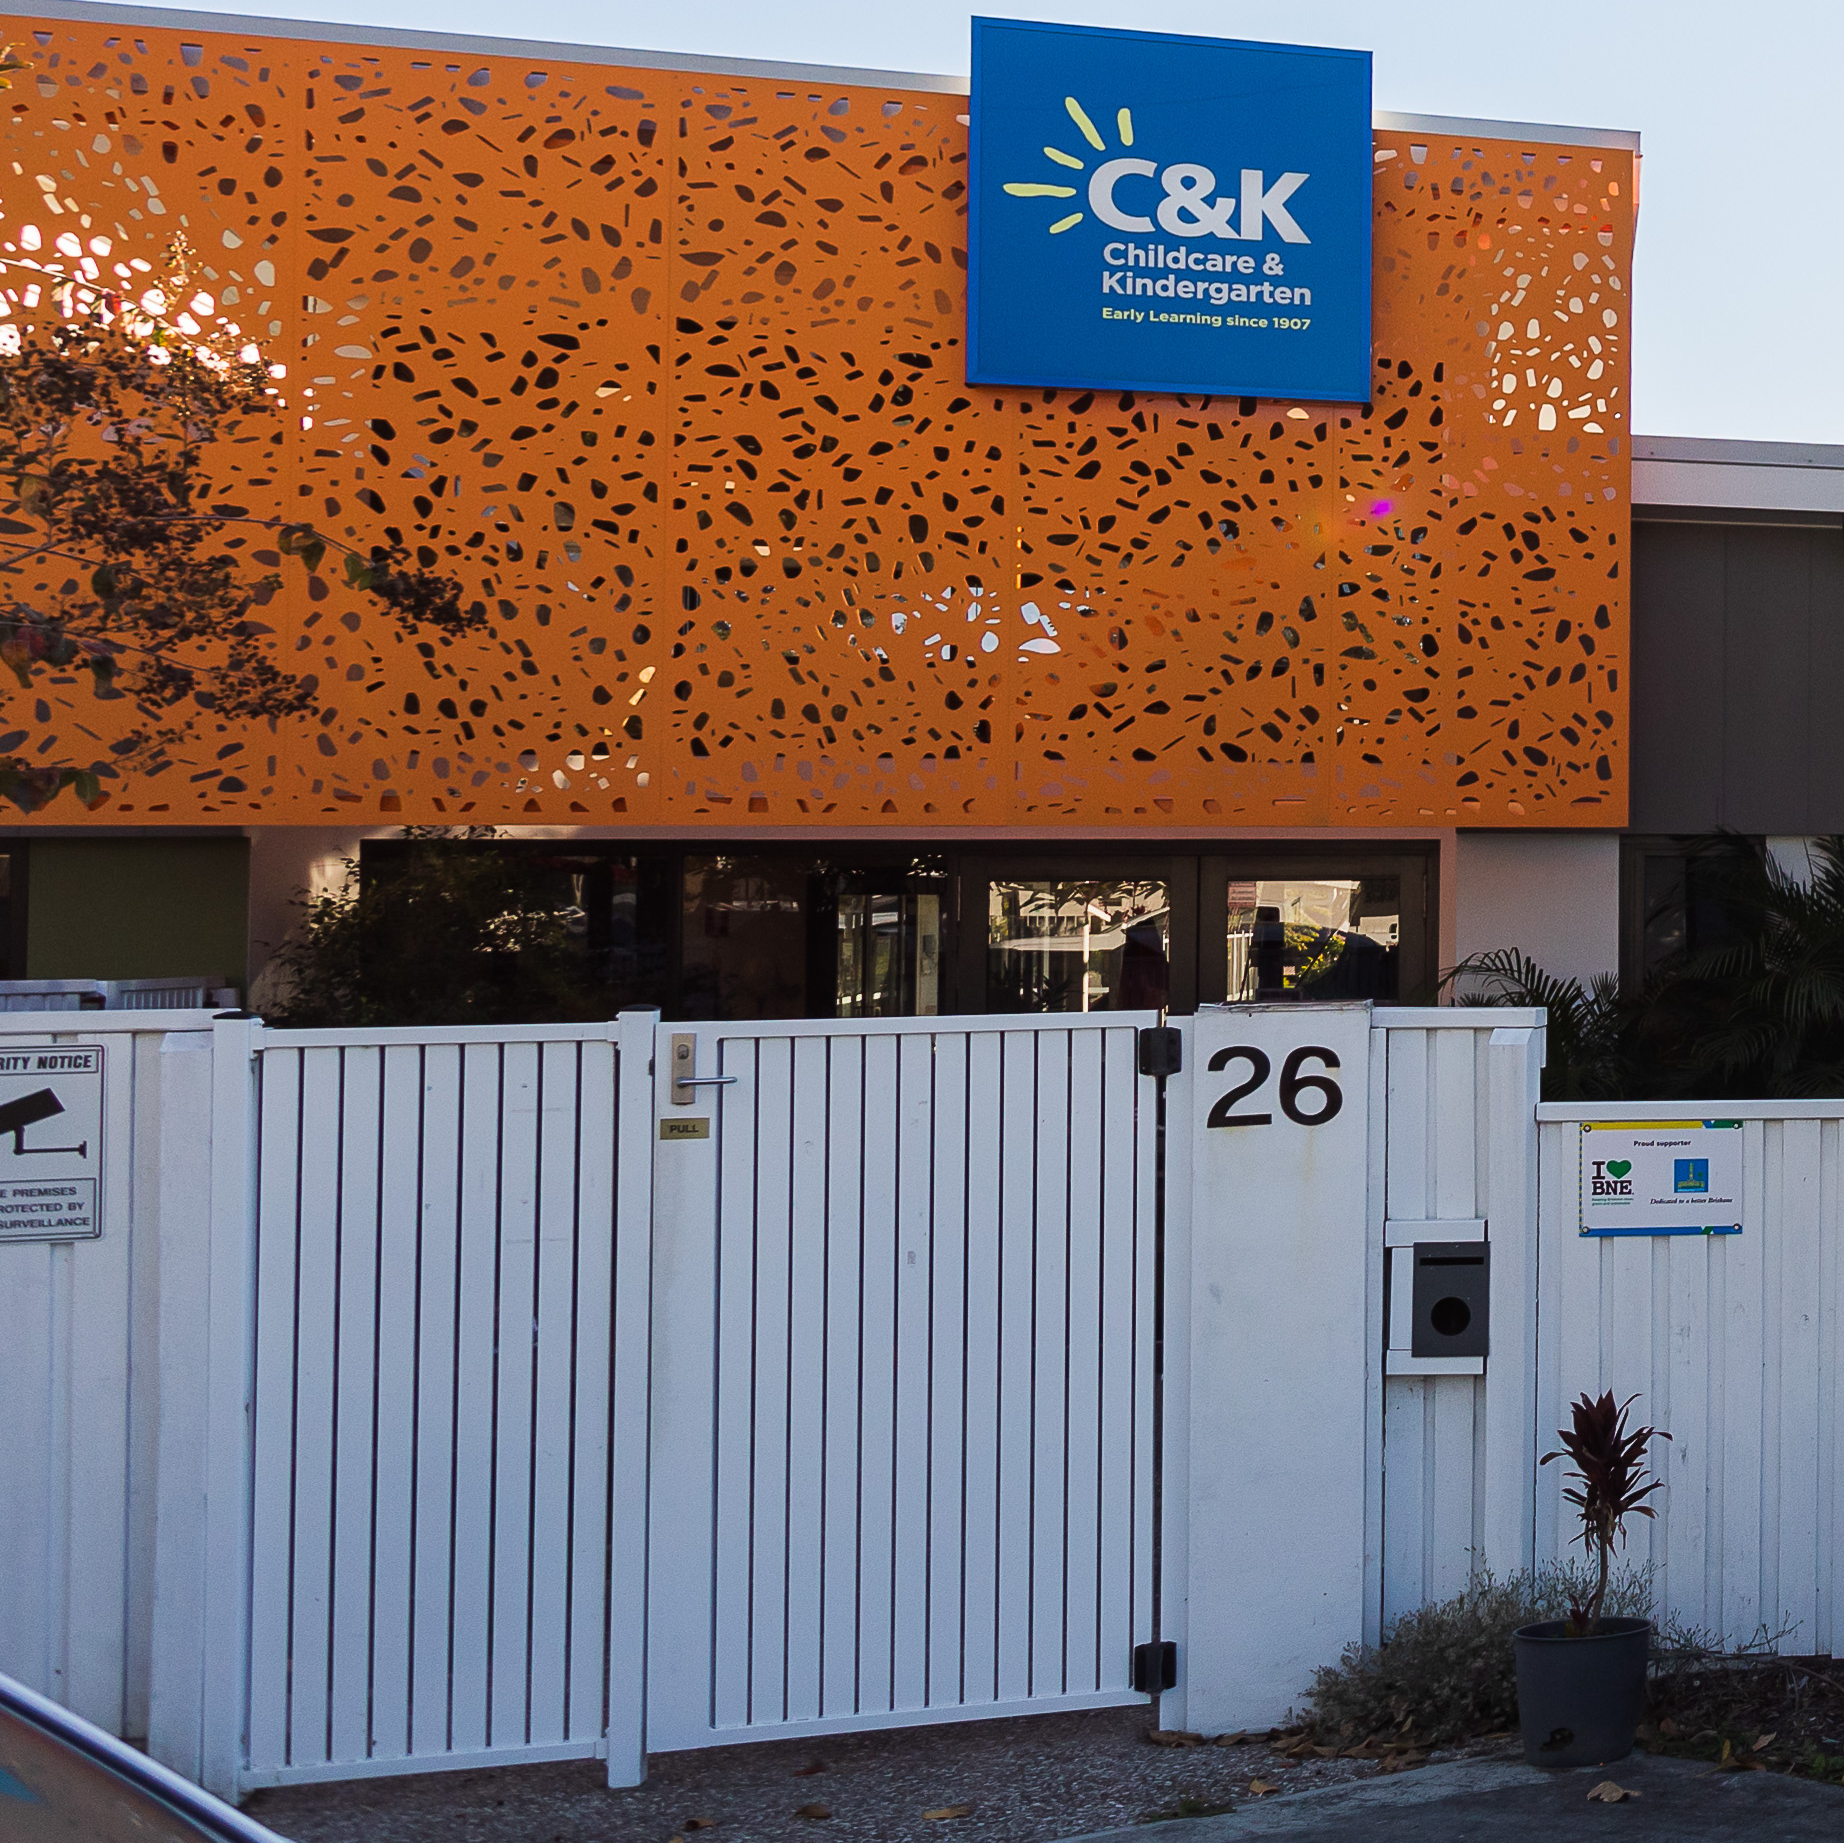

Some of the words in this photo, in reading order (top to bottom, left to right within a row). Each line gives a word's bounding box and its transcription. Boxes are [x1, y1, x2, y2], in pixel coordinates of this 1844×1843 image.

[1088, 158, 1311, 245] C&K
[1103, 242, 1255, 275] Childcare
[1262, 253, 1284, 275] &
[1102, 272, 1311, 306] Kindergarten
[1102, 308, 1144, 323] Early
[1150, 310, 1222, 328] Learning
[1226, 313, 1267, 328] since
[1273, 317, 1310, 330] 1907
[37, 1055, 92, 1069] NOTICE
[1206, 1045, 1343, 1128] 26
[669, 1125, 699, 1133] PULL
[1592, 1161, 1605, 1180] I
[13, 1187, 76, 1197] PREMISES
[68, 1202, 85, 1211] BY
[0, 1217, 90, 1229] SURVEILLANCE
